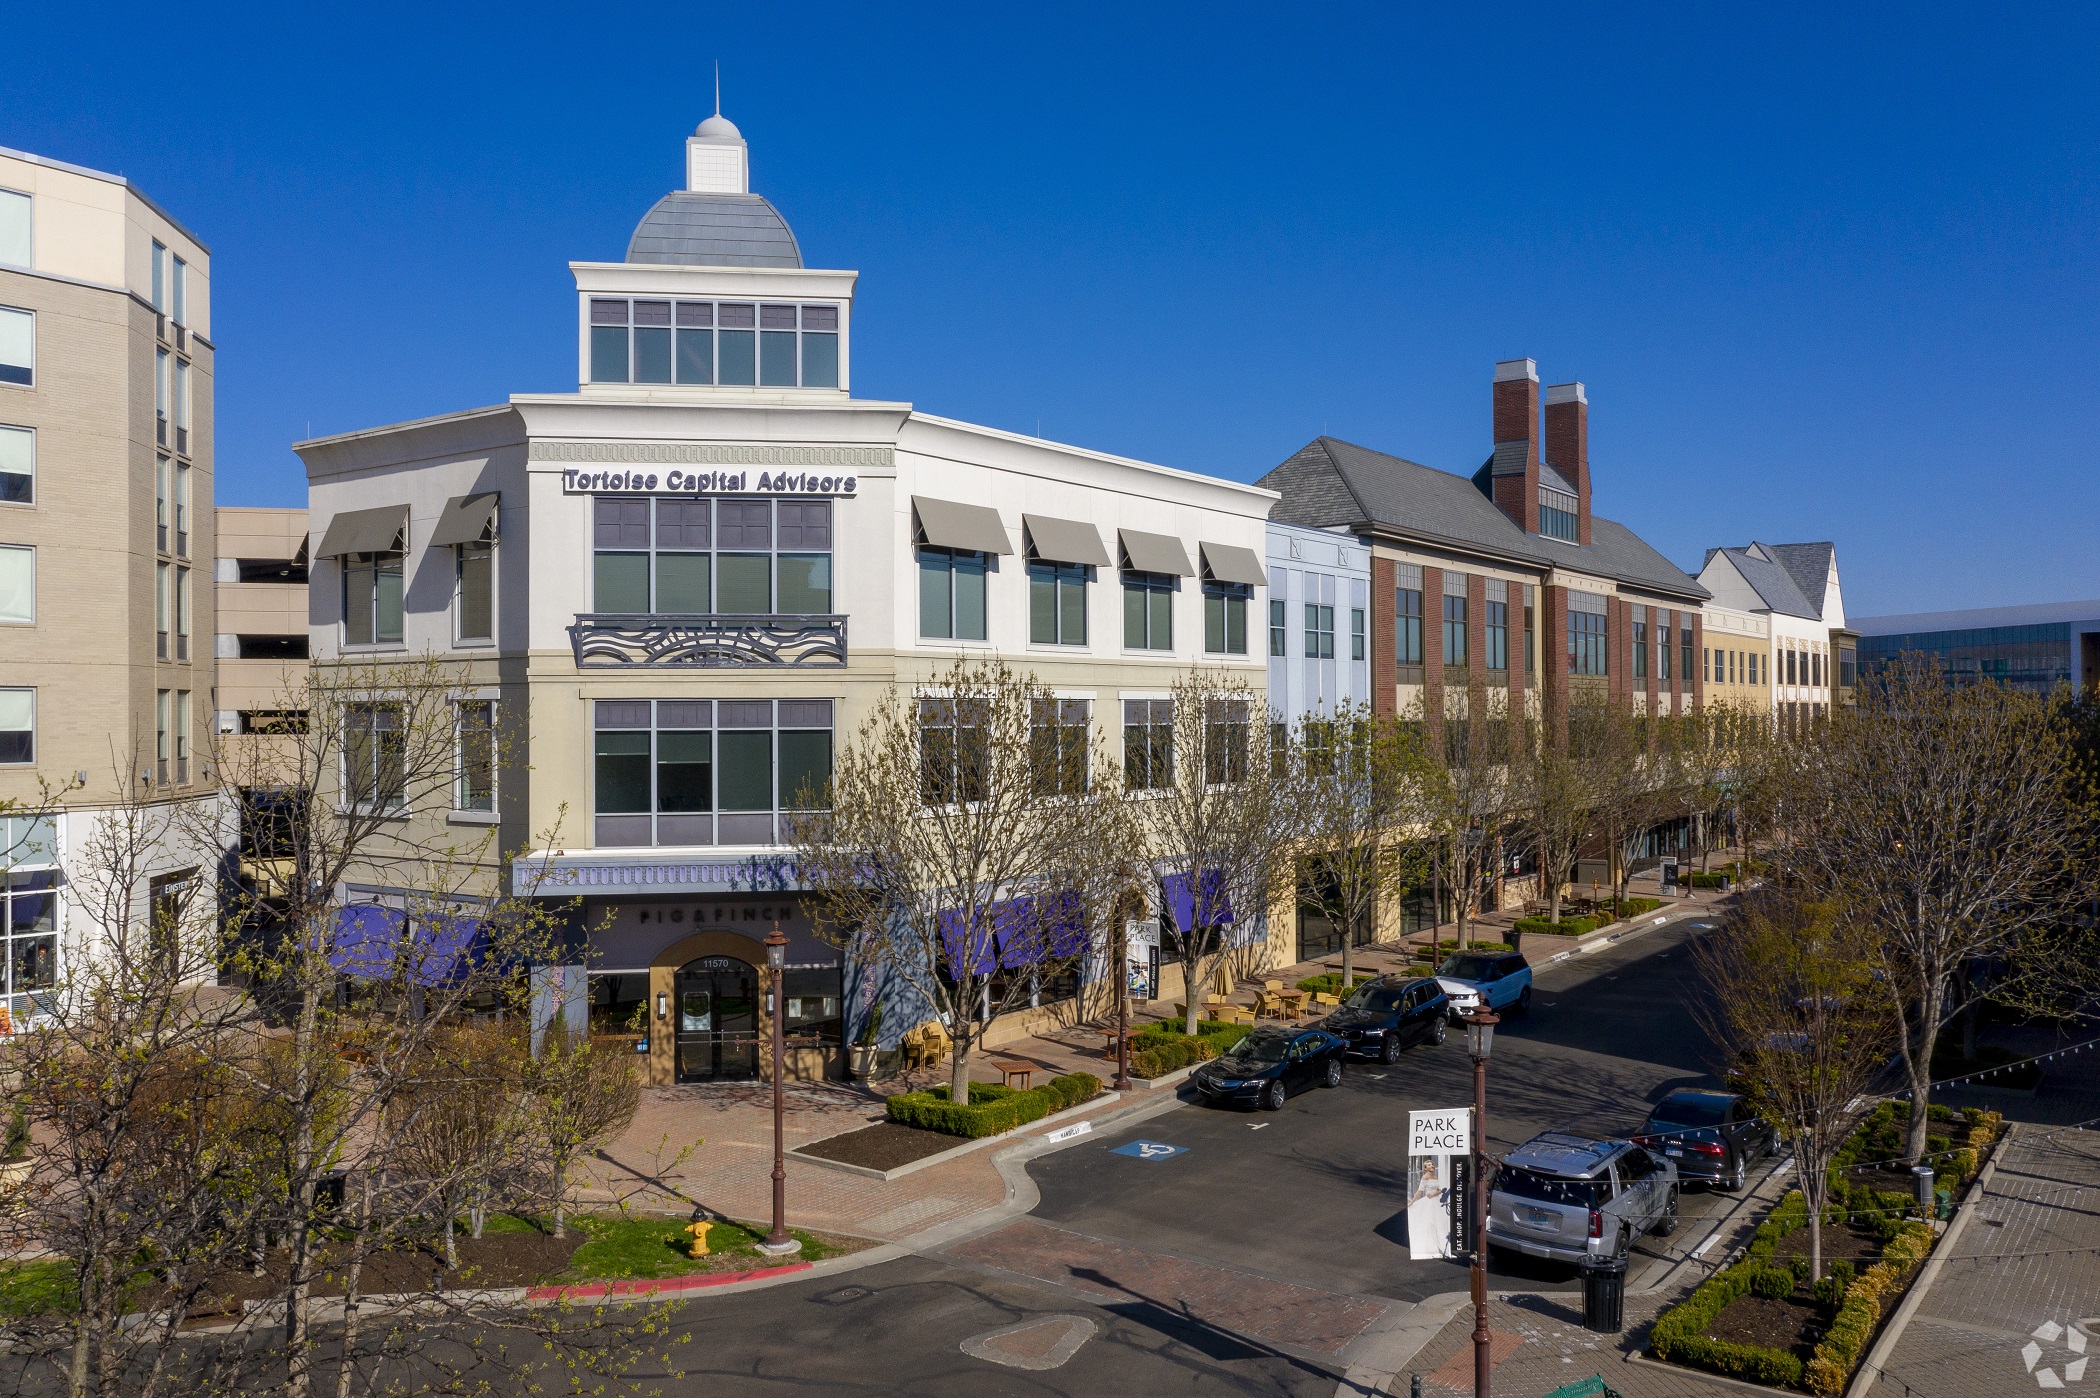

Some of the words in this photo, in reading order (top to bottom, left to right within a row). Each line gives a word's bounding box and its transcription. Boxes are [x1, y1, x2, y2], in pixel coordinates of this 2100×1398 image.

[564, 469, 658, 490] Tortoise
[667, 470, 746, 492] Capital
[757, 471, 857, 493] Advisors
[640, 909, 684, 925] PIG
[714, 906, 791, 922] FINCH
[703, 959, 729, 968] 11570
[1415, 1117, 1457, 1132] PARK
[1415, 1134, 1464, 1149] PLACE
